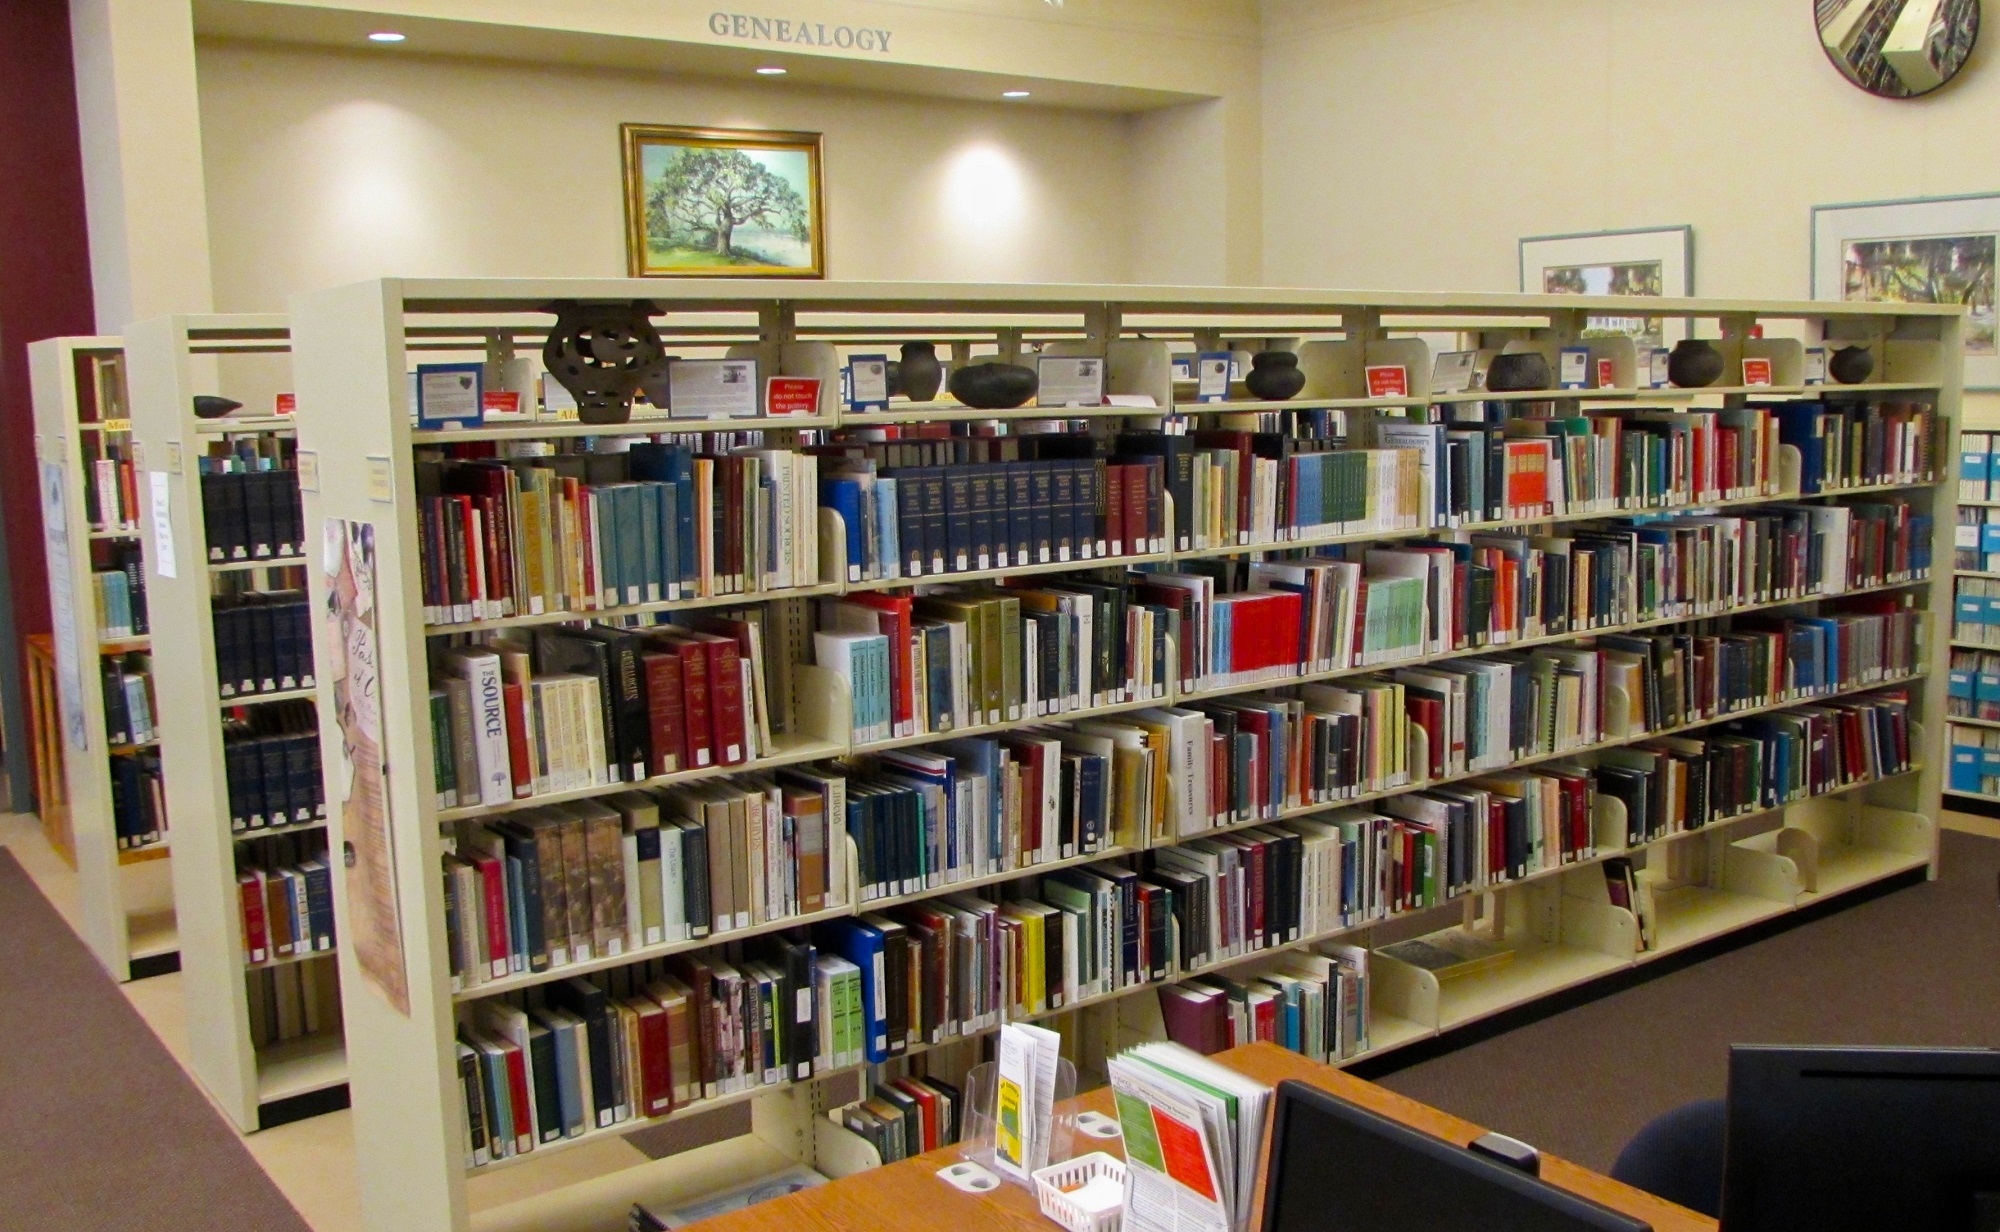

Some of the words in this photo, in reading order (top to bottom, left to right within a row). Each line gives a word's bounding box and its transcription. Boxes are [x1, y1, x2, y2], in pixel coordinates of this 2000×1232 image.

[708, 12, 892, 52] GENEALOGY
[773, 392, 782, 400] do
[783, 392, 795, 400] not
[795, 391, 813, 400] touch
[775, 402, 786, 410] the
[784, 382, 805, 391] Please
[782, 466, 791, 517] PRINTED
[782, 519, 791, 565] SOURCES
[482, 677, 502, 738] SOURCE
[1186, 740, 1194, 769] Family
[832, 784, 842, 825] LIBRARY
[752, 803, 762, 850] ARCHIVES
